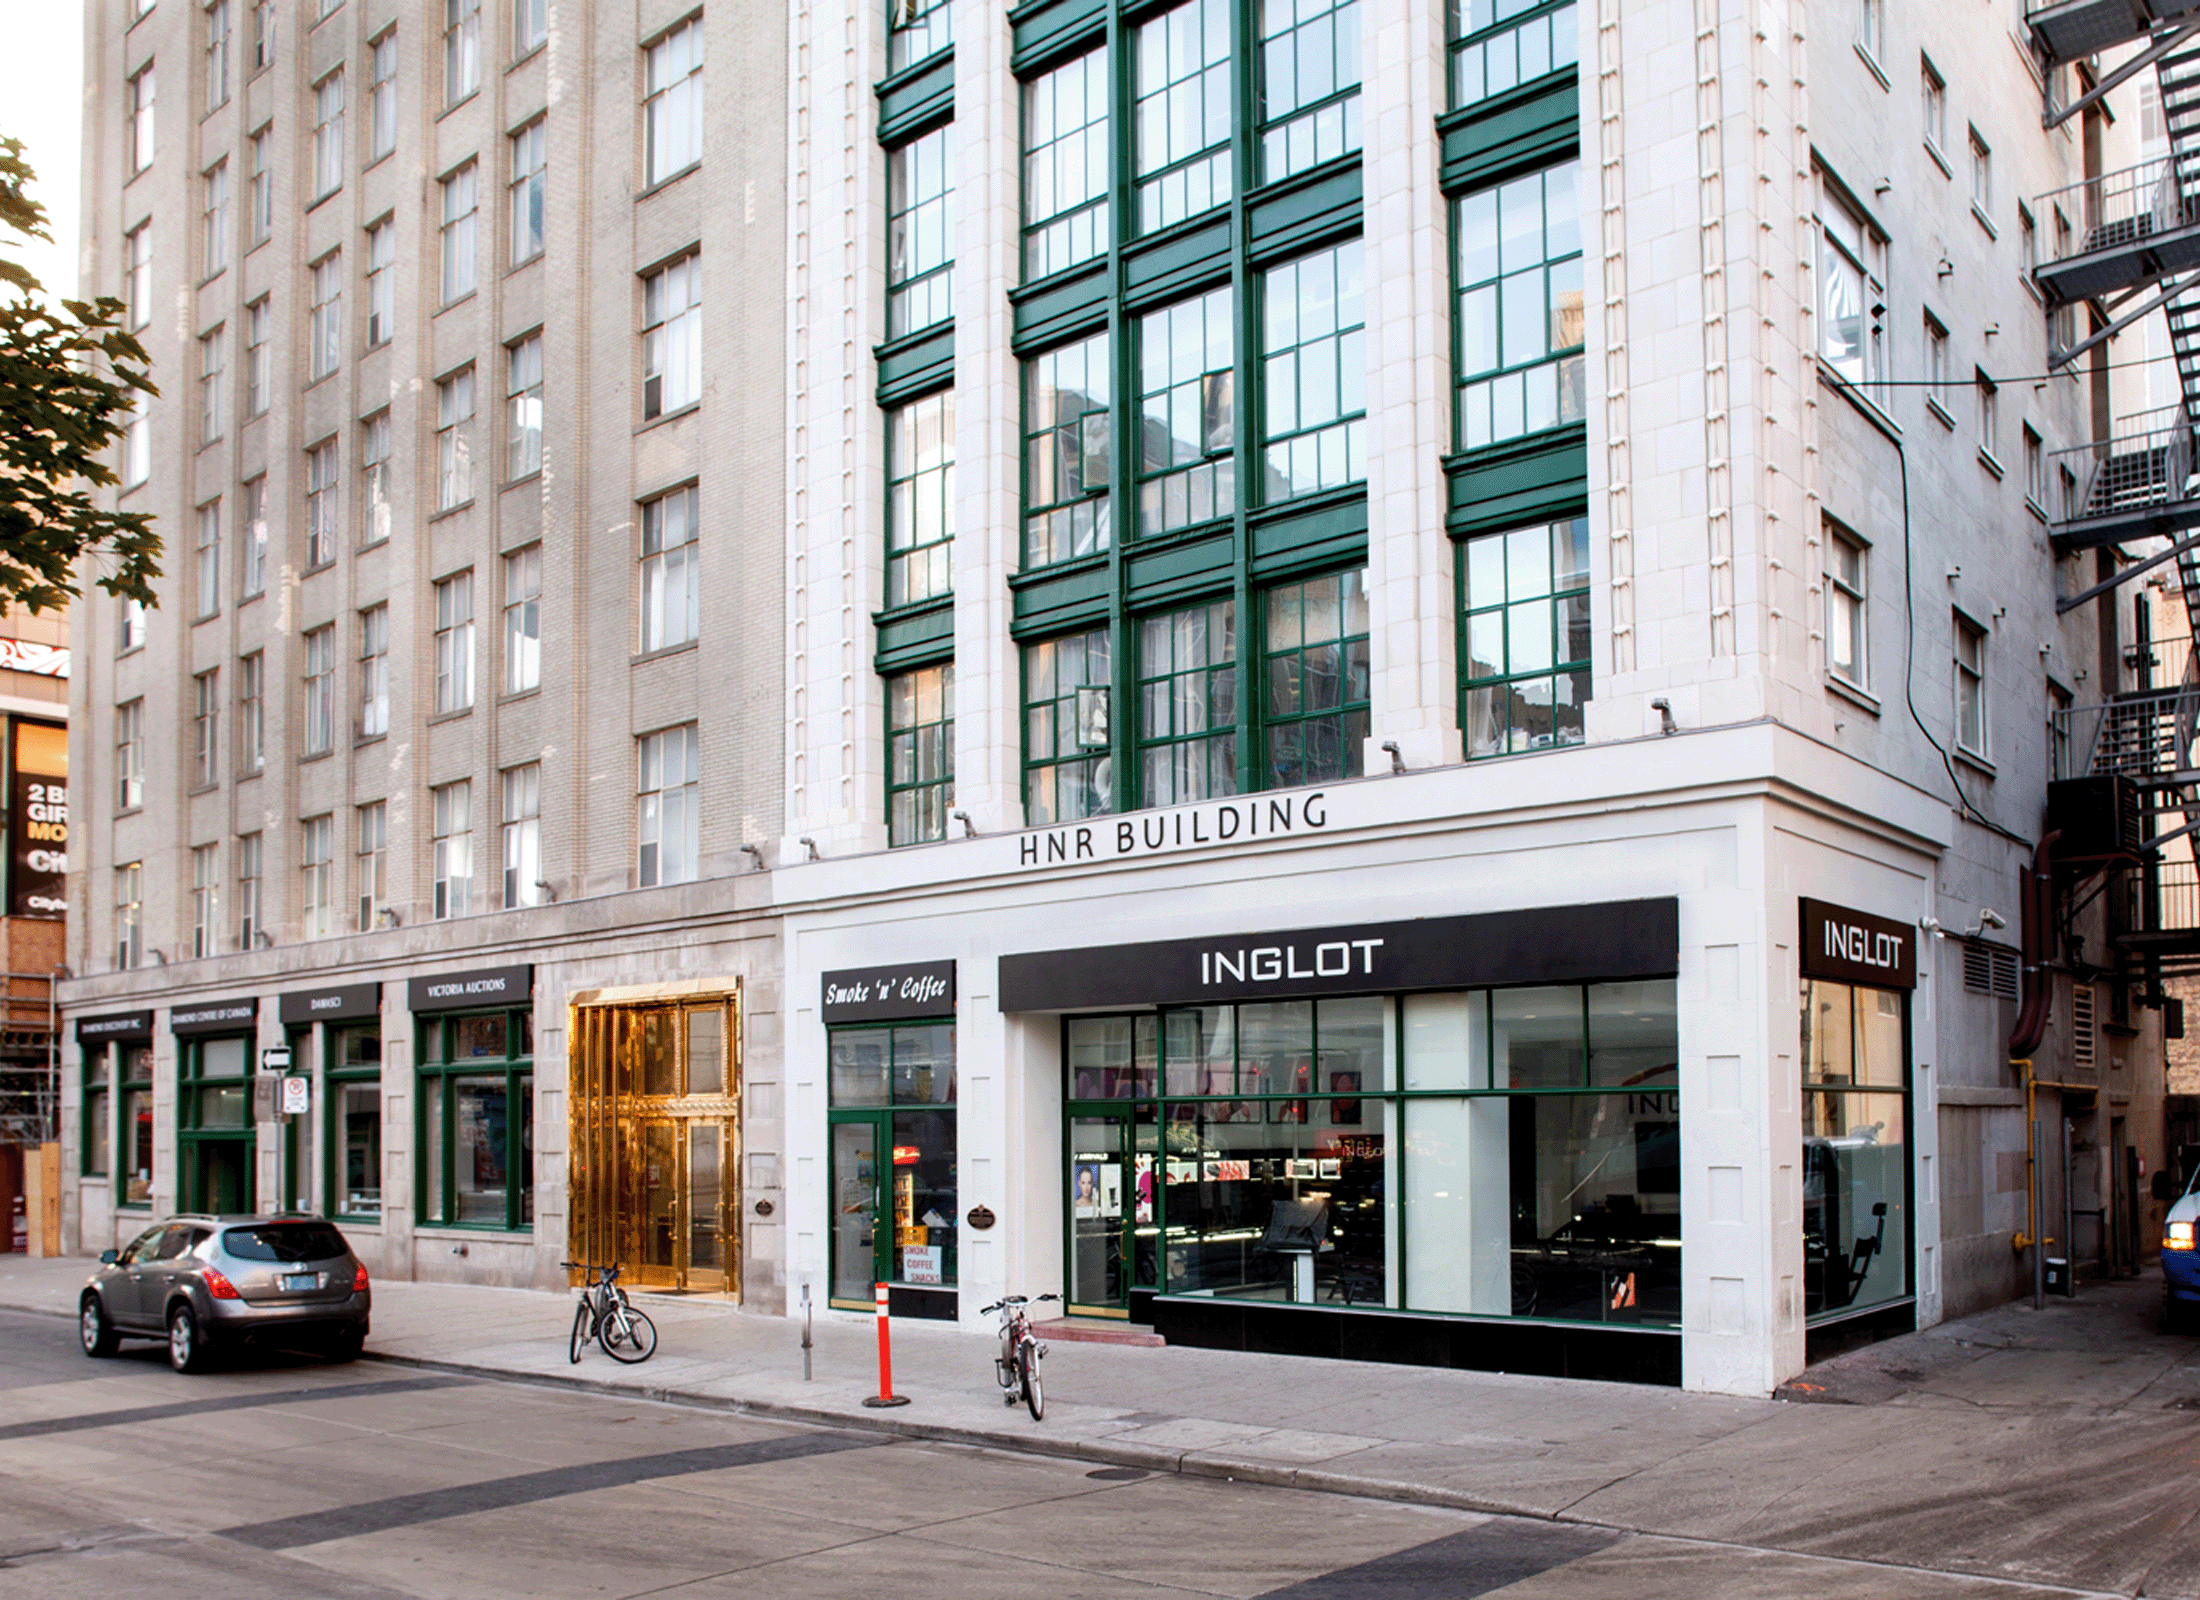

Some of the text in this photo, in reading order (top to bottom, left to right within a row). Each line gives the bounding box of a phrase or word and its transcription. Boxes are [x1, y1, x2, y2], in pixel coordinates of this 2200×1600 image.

[27, 783, 68, 804] 2 B
[1020, 793, 1326, 865] HNR BUILDING
[1824, 919, 1903, 970] INGLOT
[1201, 938, 1384, 985] INGLOT
[427, 977, 506, 998] VICTORIA AUCTIONS
[825, 981, 870, 1005] Smoke
[900, 975, 947, 1003] Coffee
[226, 1006, 251, 1019] CANADA
[904, 1245, 929, 1256] SMOKE
[906, 1259, 933, 1270] COFFEE
[910, 1272, 940, 1284] SNACKS
